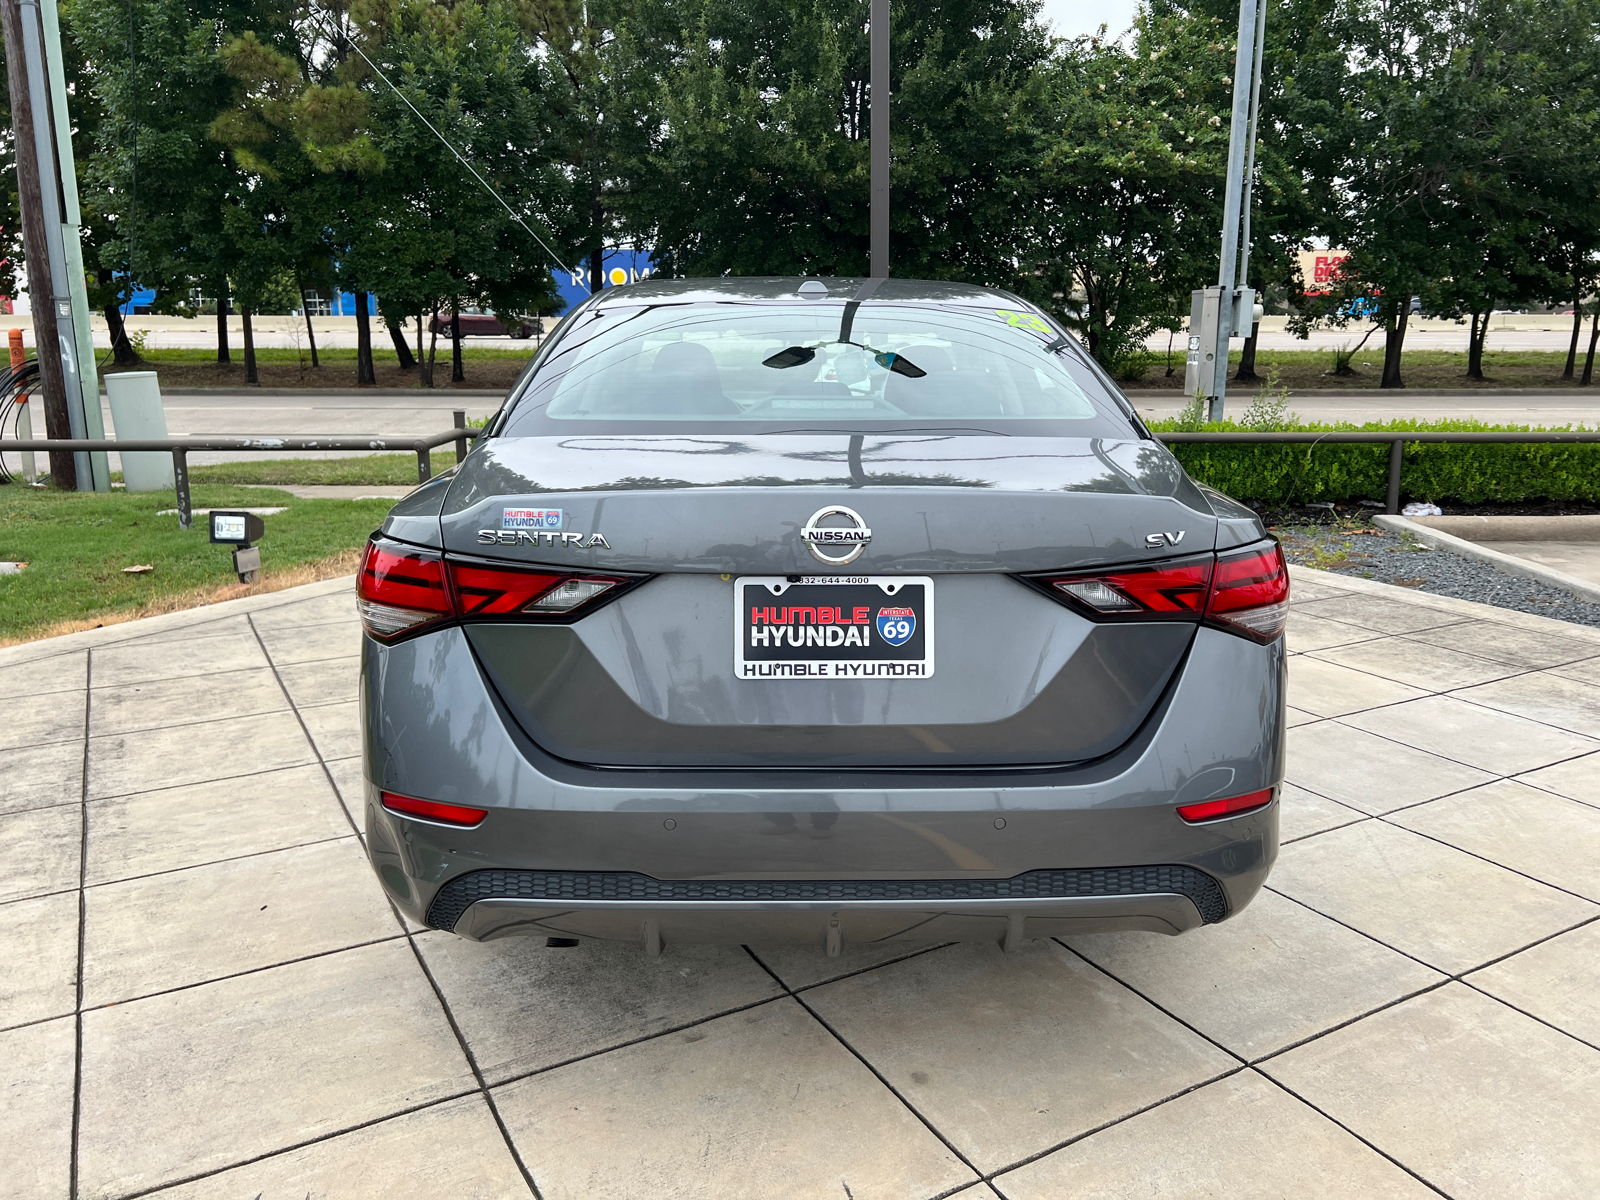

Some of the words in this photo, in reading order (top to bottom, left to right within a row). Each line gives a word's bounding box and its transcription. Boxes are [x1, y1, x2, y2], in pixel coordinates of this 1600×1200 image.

[571, 267, 660, 286] ROOM
[995, 309, 1052, 334] 23
[503, 518, 544, 527] HYUNDAI
[504, 510, 544, 518] HUMBLE
[547, 516, 558, 524] 69
[477, 529, 611, 549] SENTRA
[808, 531, 864, 541] NISSAN
[1145, 530, 1186, 549] SV
[752, 607, 870, 624] HUMBLE
[751, 626, 870, 647] HYUNDAI
[883, 621, 910, 639] 69
[743, 664, 828, 676] HUMBLE
[835, 664, 926, 676] HYUNDAI
